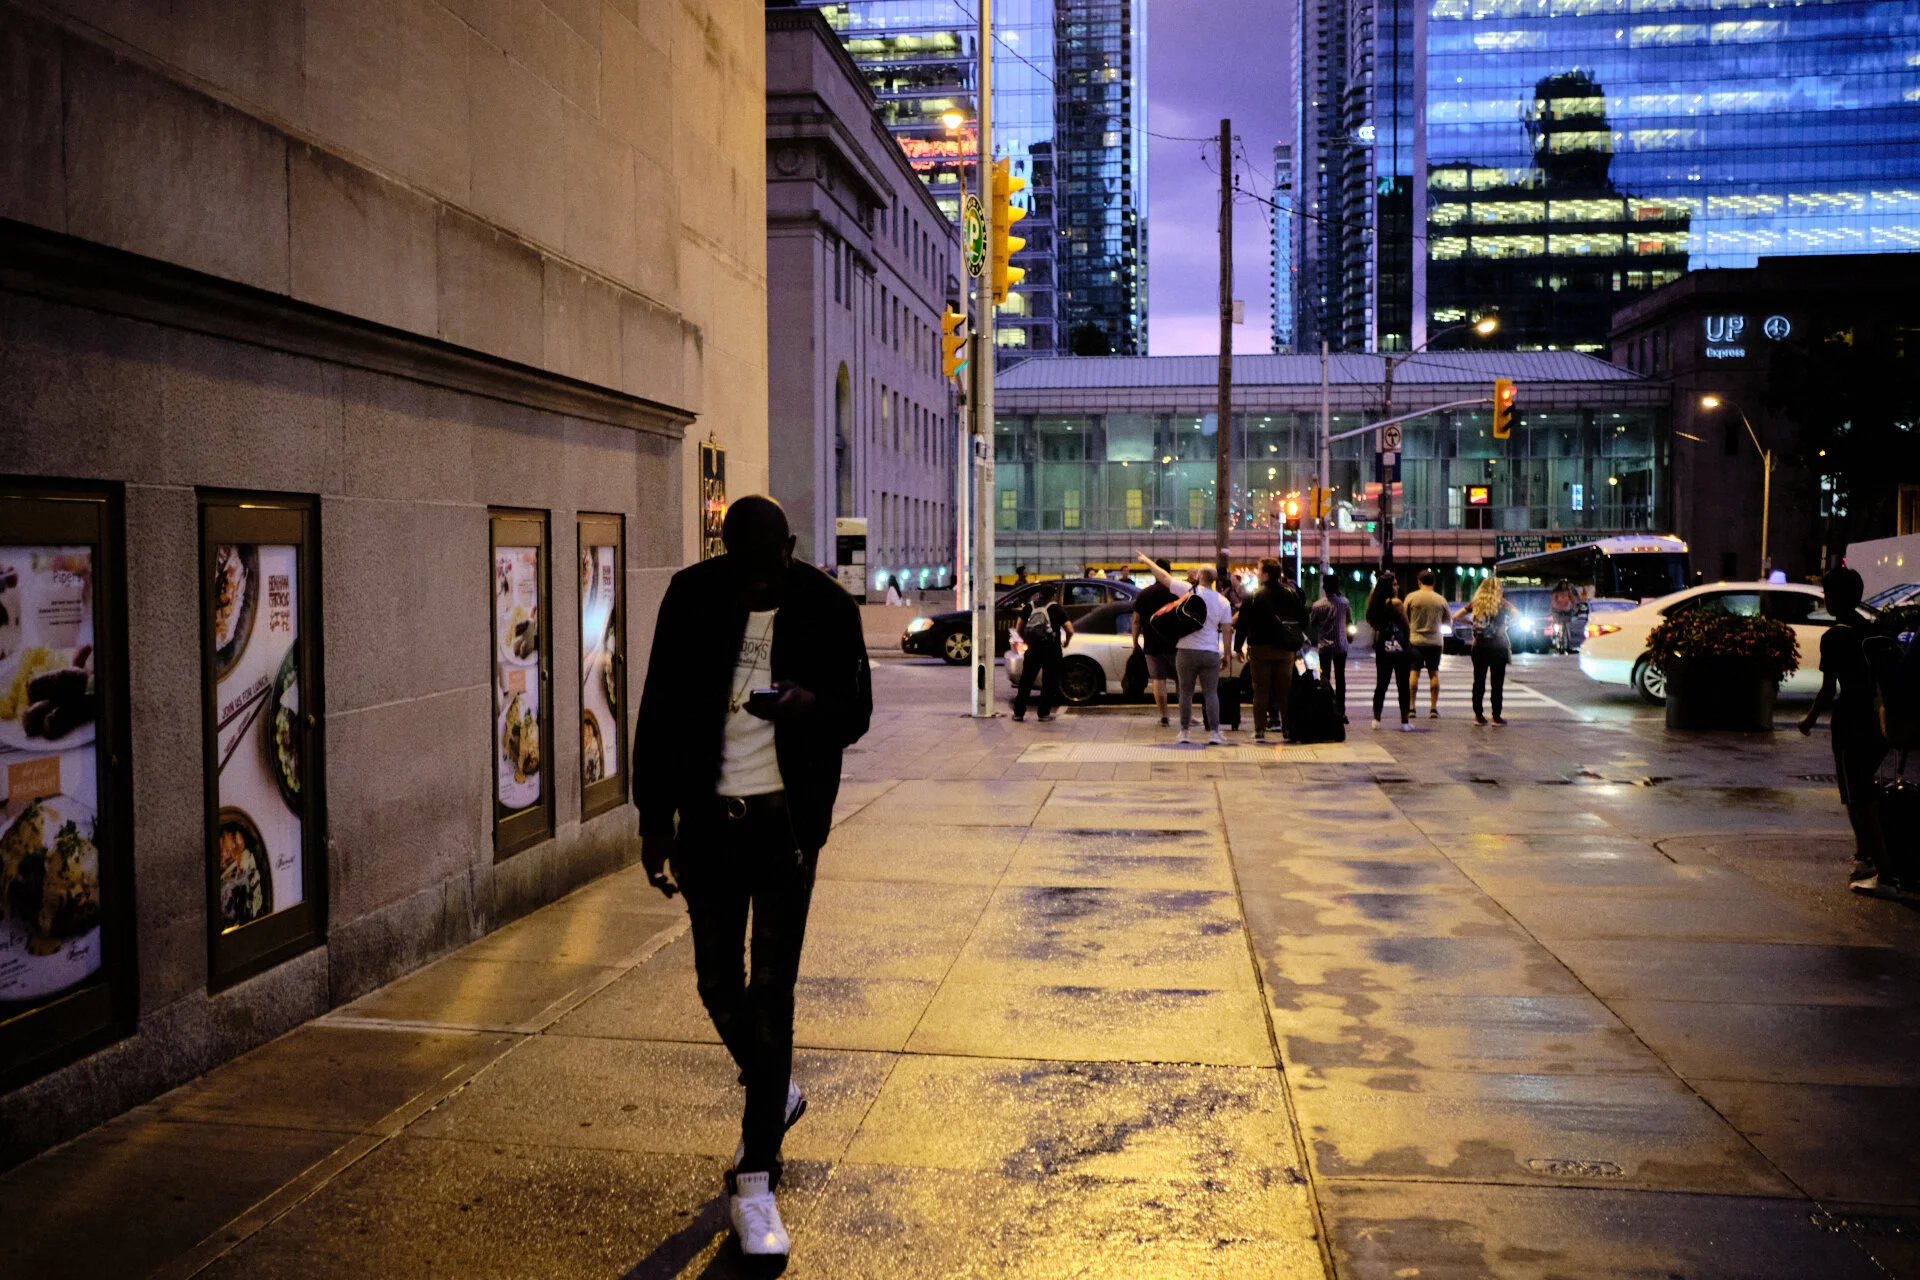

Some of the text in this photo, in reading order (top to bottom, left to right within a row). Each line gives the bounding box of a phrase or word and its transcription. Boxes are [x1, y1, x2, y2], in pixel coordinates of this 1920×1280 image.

[1706, 315, 1745, 343] UP
[1706, 347, 1746, 359] Express
[222, 672, 269, 720] JOIN US FOR LUNCH
